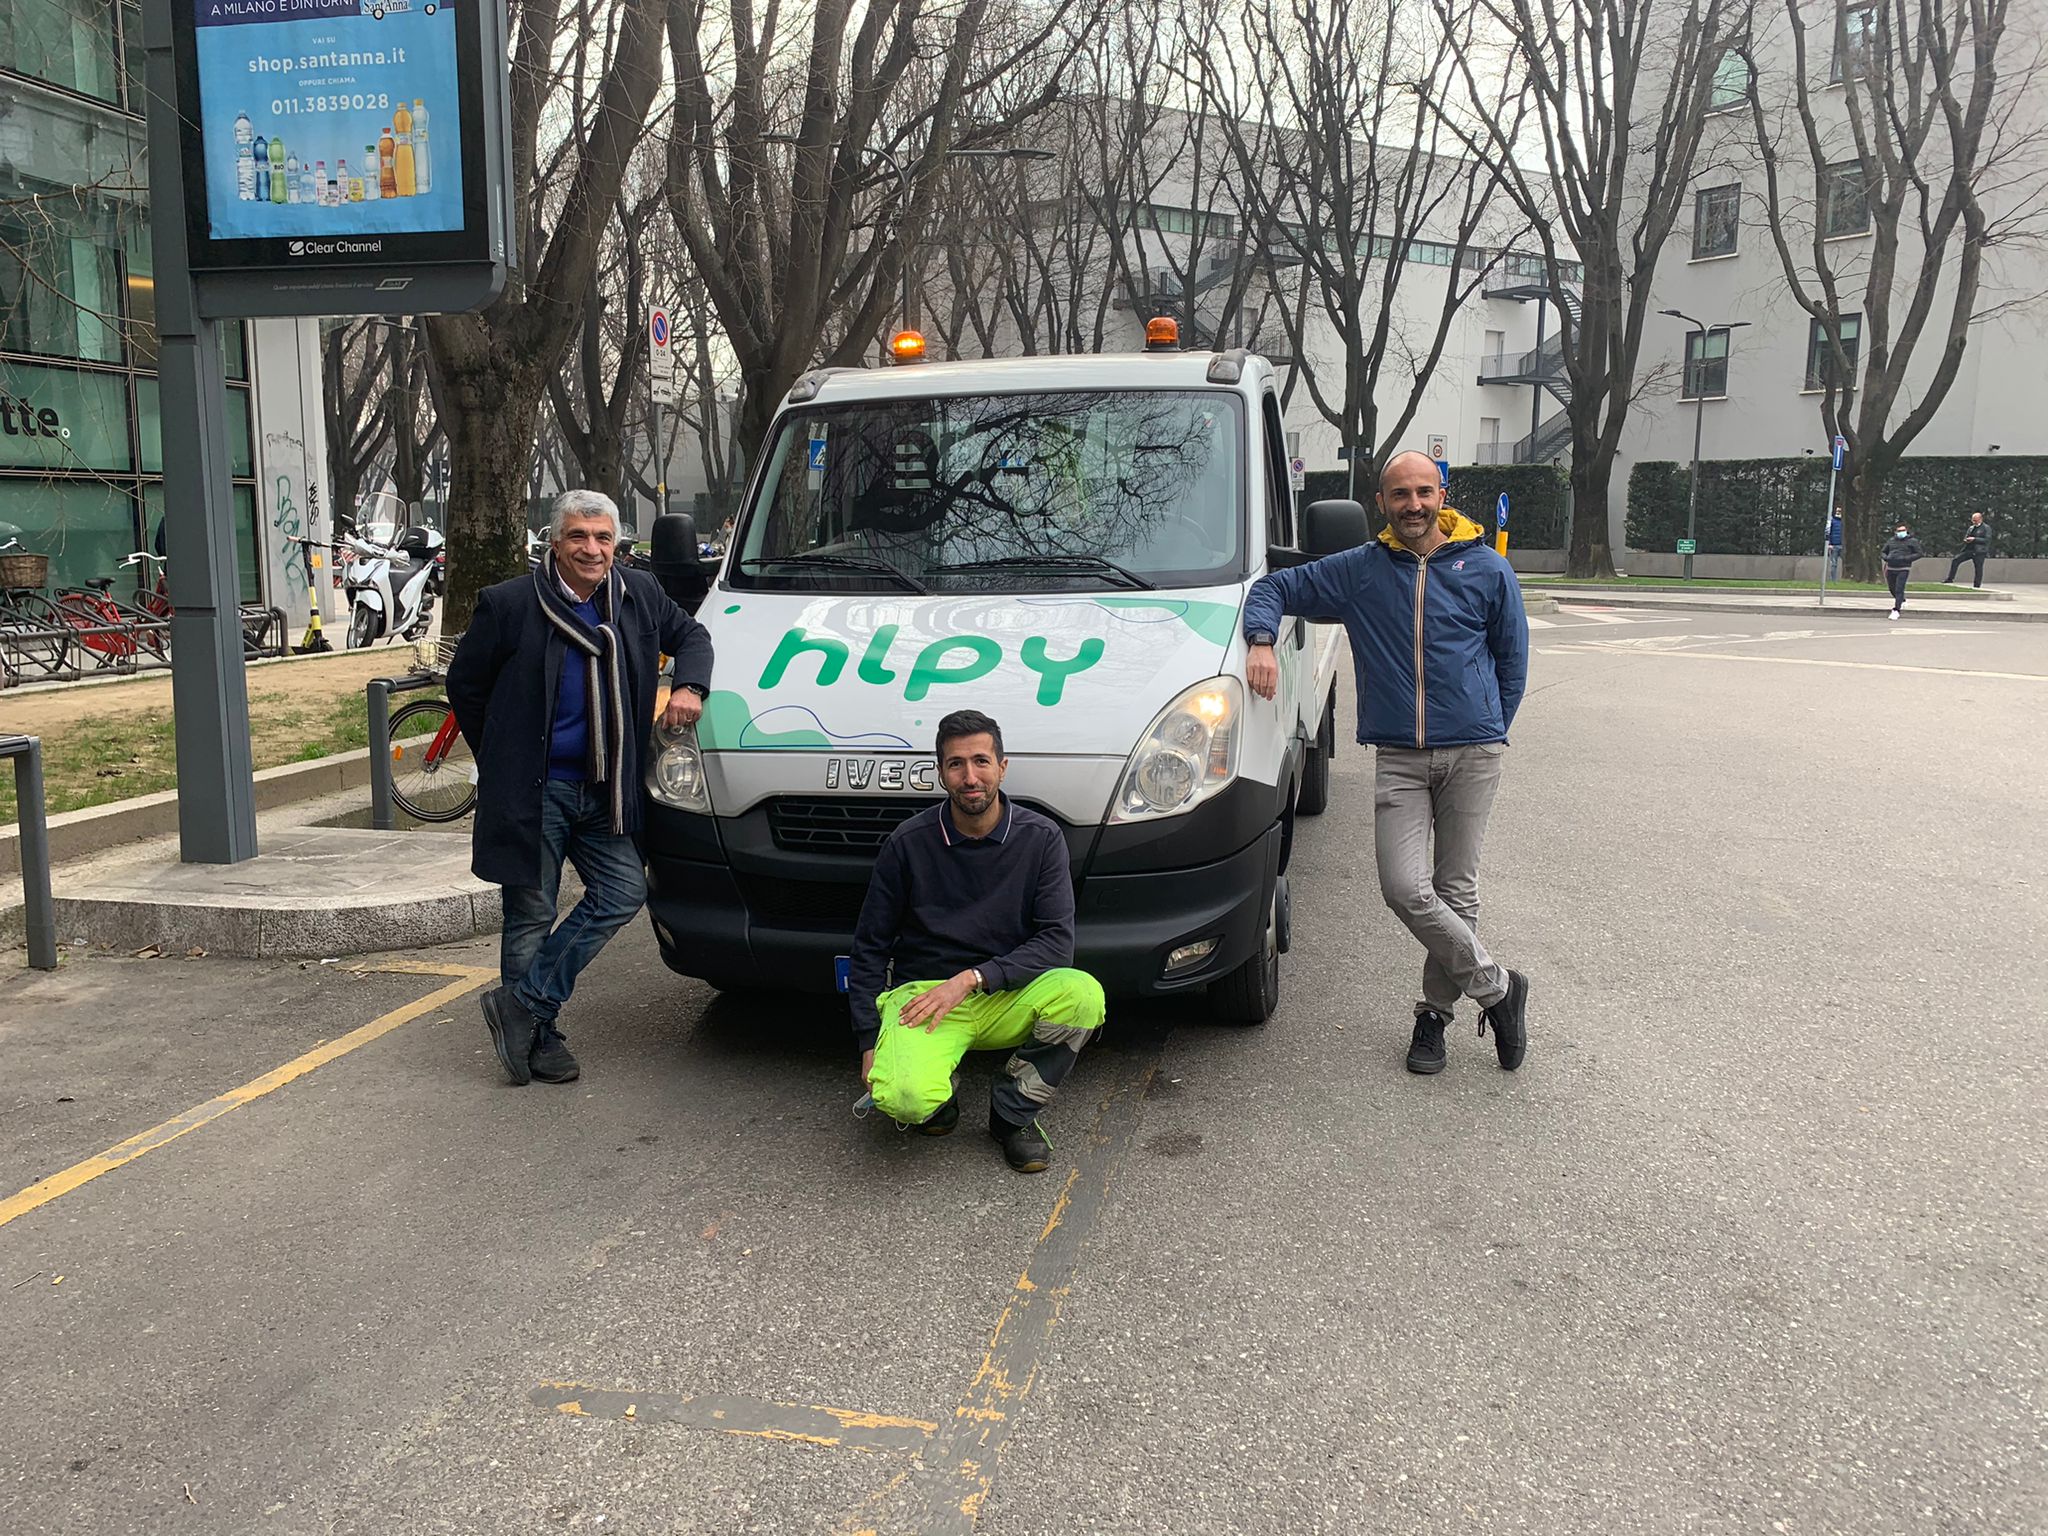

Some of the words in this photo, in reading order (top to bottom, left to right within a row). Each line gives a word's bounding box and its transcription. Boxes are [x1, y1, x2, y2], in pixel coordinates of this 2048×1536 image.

[211, 4, 221, 16] A
[224, 0, 276, 15] MILANO
[280, 0, 288, 11] E
[249, 48, 405, 73] shop.santanna.it
[298, 78, 325, 87] OPPURE
[327, 76, 356, 85] CHIAMA
[271, 93, 389, 115] 011.3839028
[305, 241, 334, 254] Clear
[336, 240, 382, 253] Channel
[825, 758, 946, 791] IVEC
